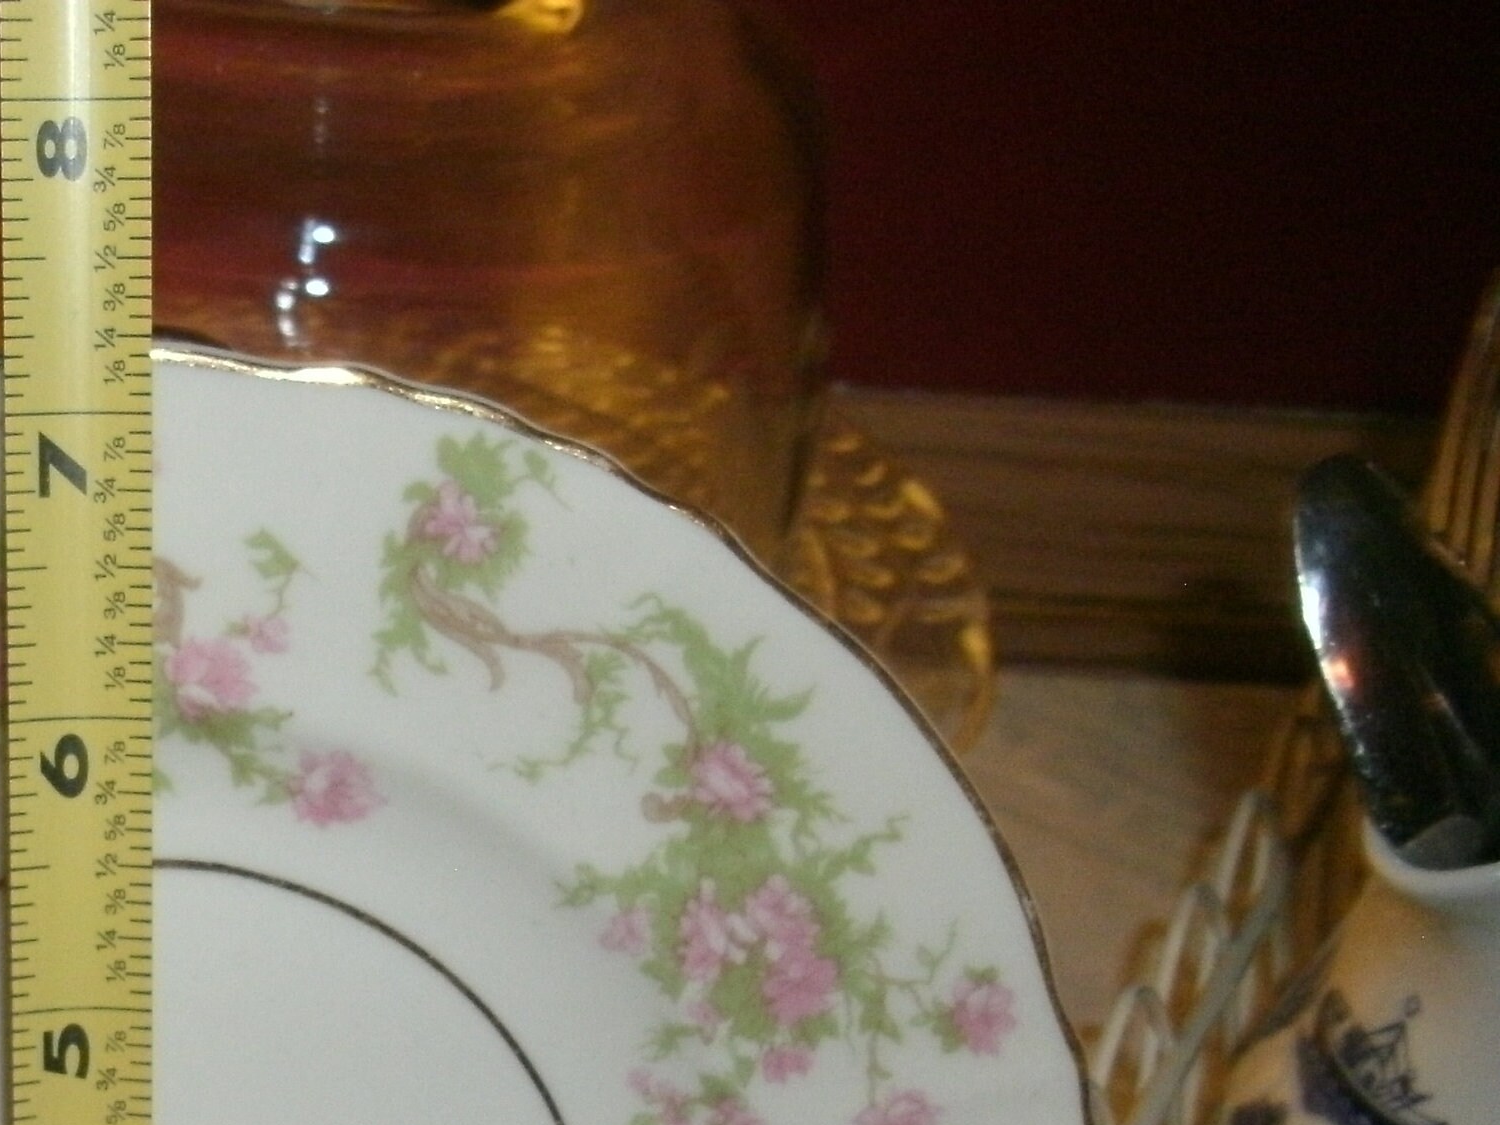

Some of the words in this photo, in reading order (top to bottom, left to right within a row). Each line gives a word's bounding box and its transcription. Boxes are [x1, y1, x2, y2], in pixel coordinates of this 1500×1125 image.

[93, 10, 115, 35] 1/4
[105, 44, 125, 68] 1/8
[36, 116, 87, 182] 8
[105, 123, 125, 149] 7/8
[93, 166, 115, 192] 3/4
[105, 203, 125, 231] 5/8
[94, 245, 116, 272] 1/2
[105, 283, 126, 311] 3/8
[94, 327, 116, 351] 1/4
[105, 359, 126, 384] 1/8
[103, 436, 125, 461] 7/8
[38, 432, 87, 498] 7
[94, 478, 117, 503] 3/4
[104, 513, 126, 541] 5/8
[94, 554, 117, 581] 1/2
[104, 592, 126, 619] 3/8
[95, 634, 117, 657] 1/4
[104, 666, 126, 688] 1/8
[40, 733, 88, 797] 6
[104, 741, 126, 763] 7/8
[95, 779, 117, 805] 3/4
[104, 814, 126, 840] 5/8
[96, 853, 118, 877] 1/2
[106, 888, 126, 914] 3/8
[97, 929, 117, 950] 1/4
[106, 960, 126, 982] 1/8
[43, 1023, 89, 1080] 5
